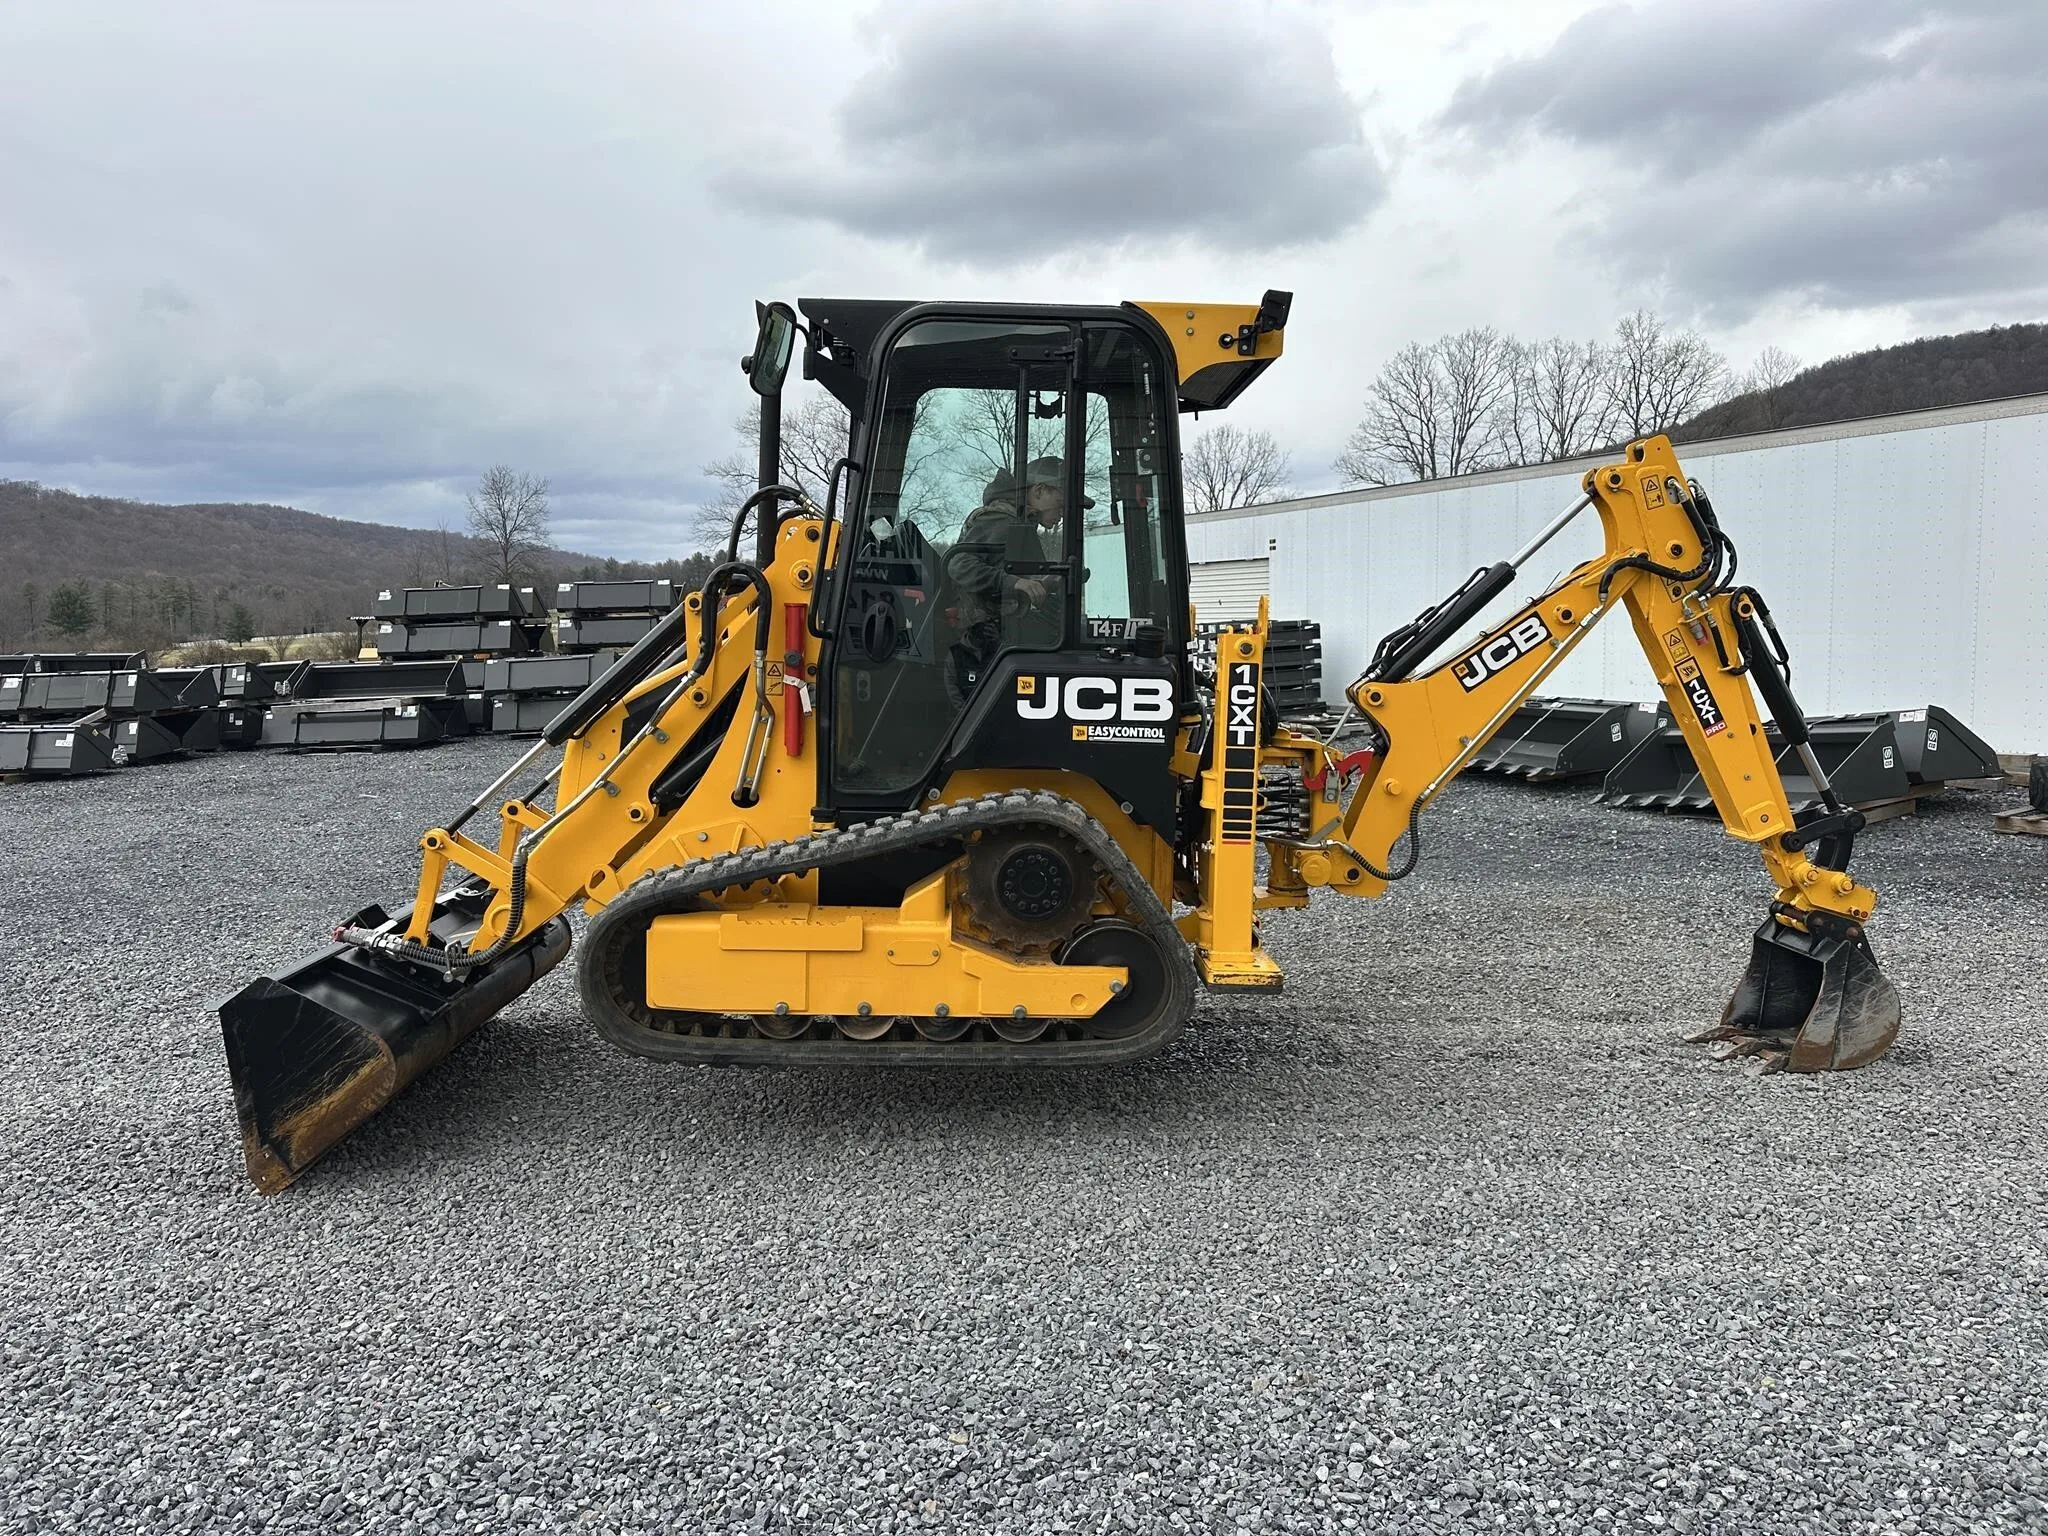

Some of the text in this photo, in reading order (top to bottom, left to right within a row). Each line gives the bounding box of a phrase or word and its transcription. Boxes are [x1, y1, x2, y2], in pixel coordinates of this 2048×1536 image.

[1462, 617, 1547, 687] JCB
[1017, 676, 1174, 722] JCB
[1229, 664, 1255, 745] 1CXT
[1689, 679, 1716, 725] 1CXT
[1705, 722, 1726, 736] PRO
